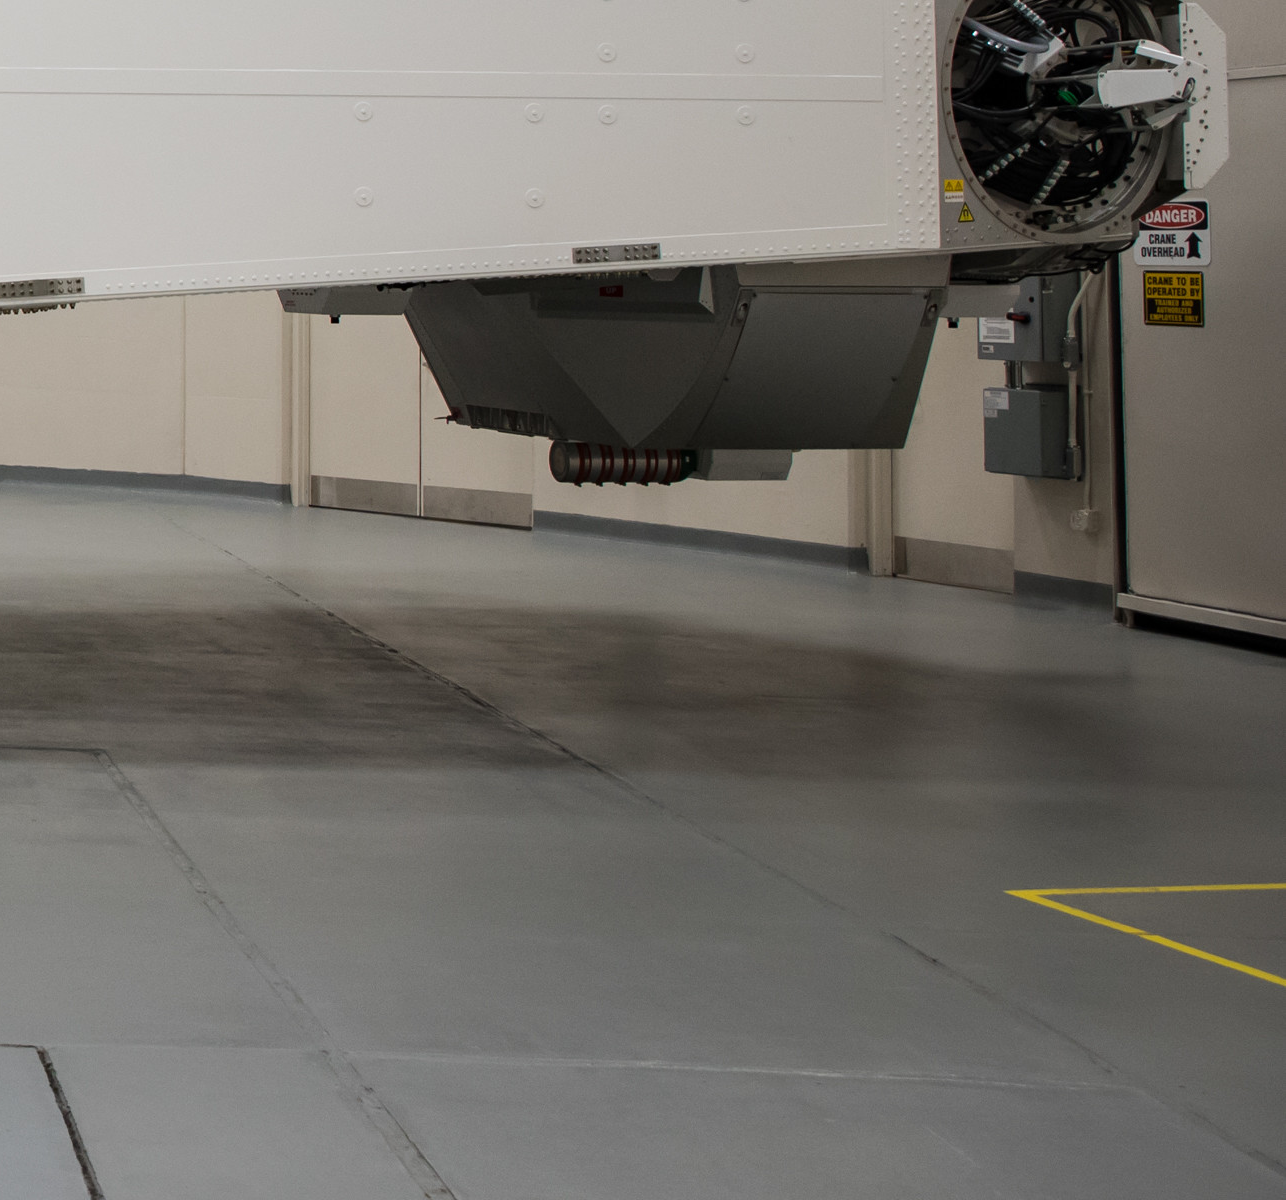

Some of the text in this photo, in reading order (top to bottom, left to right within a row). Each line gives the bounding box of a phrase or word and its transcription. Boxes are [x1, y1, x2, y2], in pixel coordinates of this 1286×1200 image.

[1145, 209, 1197, 223] DANGER
[1148, 234, 1176, 244] CRANE
[1141, 247, 1185, 257] OVERHEAD
[1147, 276, 1200, 286] CRANE TO BE
[1147, 287, 1200, 296] OPERATED BY
